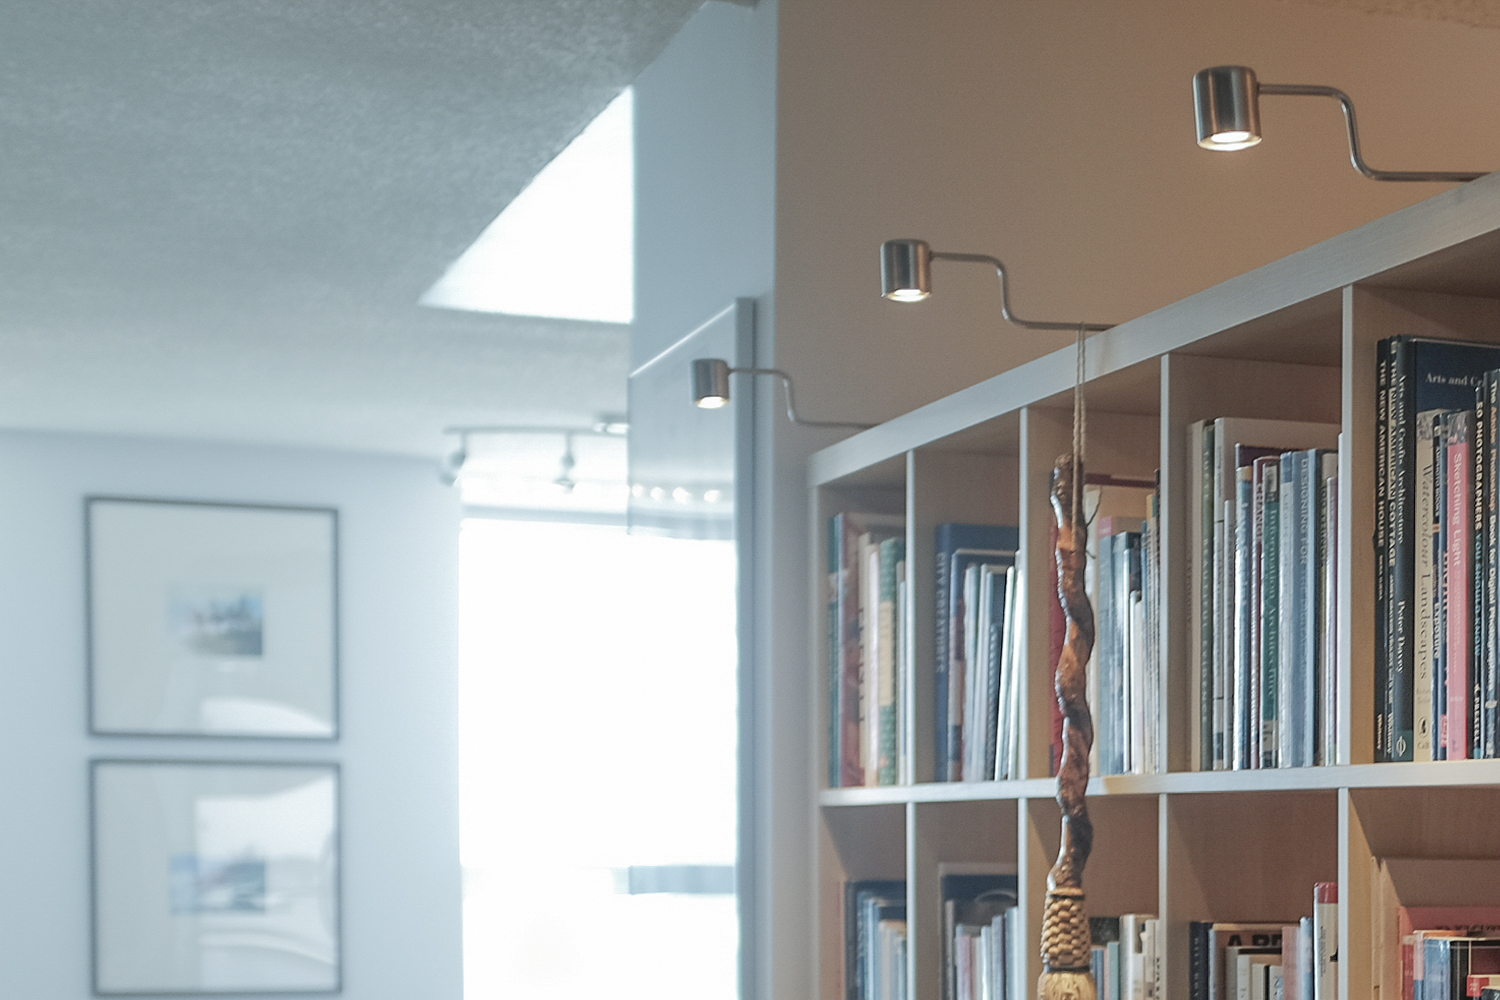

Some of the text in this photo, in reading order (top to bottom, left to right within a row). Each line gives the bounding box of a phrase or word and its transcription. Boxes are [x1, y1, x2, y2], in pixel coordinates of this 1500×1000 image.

[1425, 372, 1447, 384] Arts
[1448, 375, 1468, 386] and
[1490, 380, 1498, 404] The
[1489, 406, 1497, 444] Adobe
[1398, 375, 1406, 545] Arts and Crafts Architecture
[1475, 421, 1483, 531] PHOTOGRAPHERS
[1488, 449, 1497, 512] Photoshop
[1300, 458, 1308, 535] DESIGNING
[1452, 453, 1462, 525] Sketching
[1300, 537, 1308, 565] FOR
[1452, 529, 1462, 567] Light
[1489, 514, 1497, 547] Book
[1417, 464, 1433, 681] Watercolour Landscapes
[1487, 567, 1496, 604] Digital
[1268, 509, 1277, 697] Information Architecture
[1397, 600, 1406, 634] Peter
[1433, 602, 1441, 659] Exposure
[1487, 606, 1496, 692] Photographers
